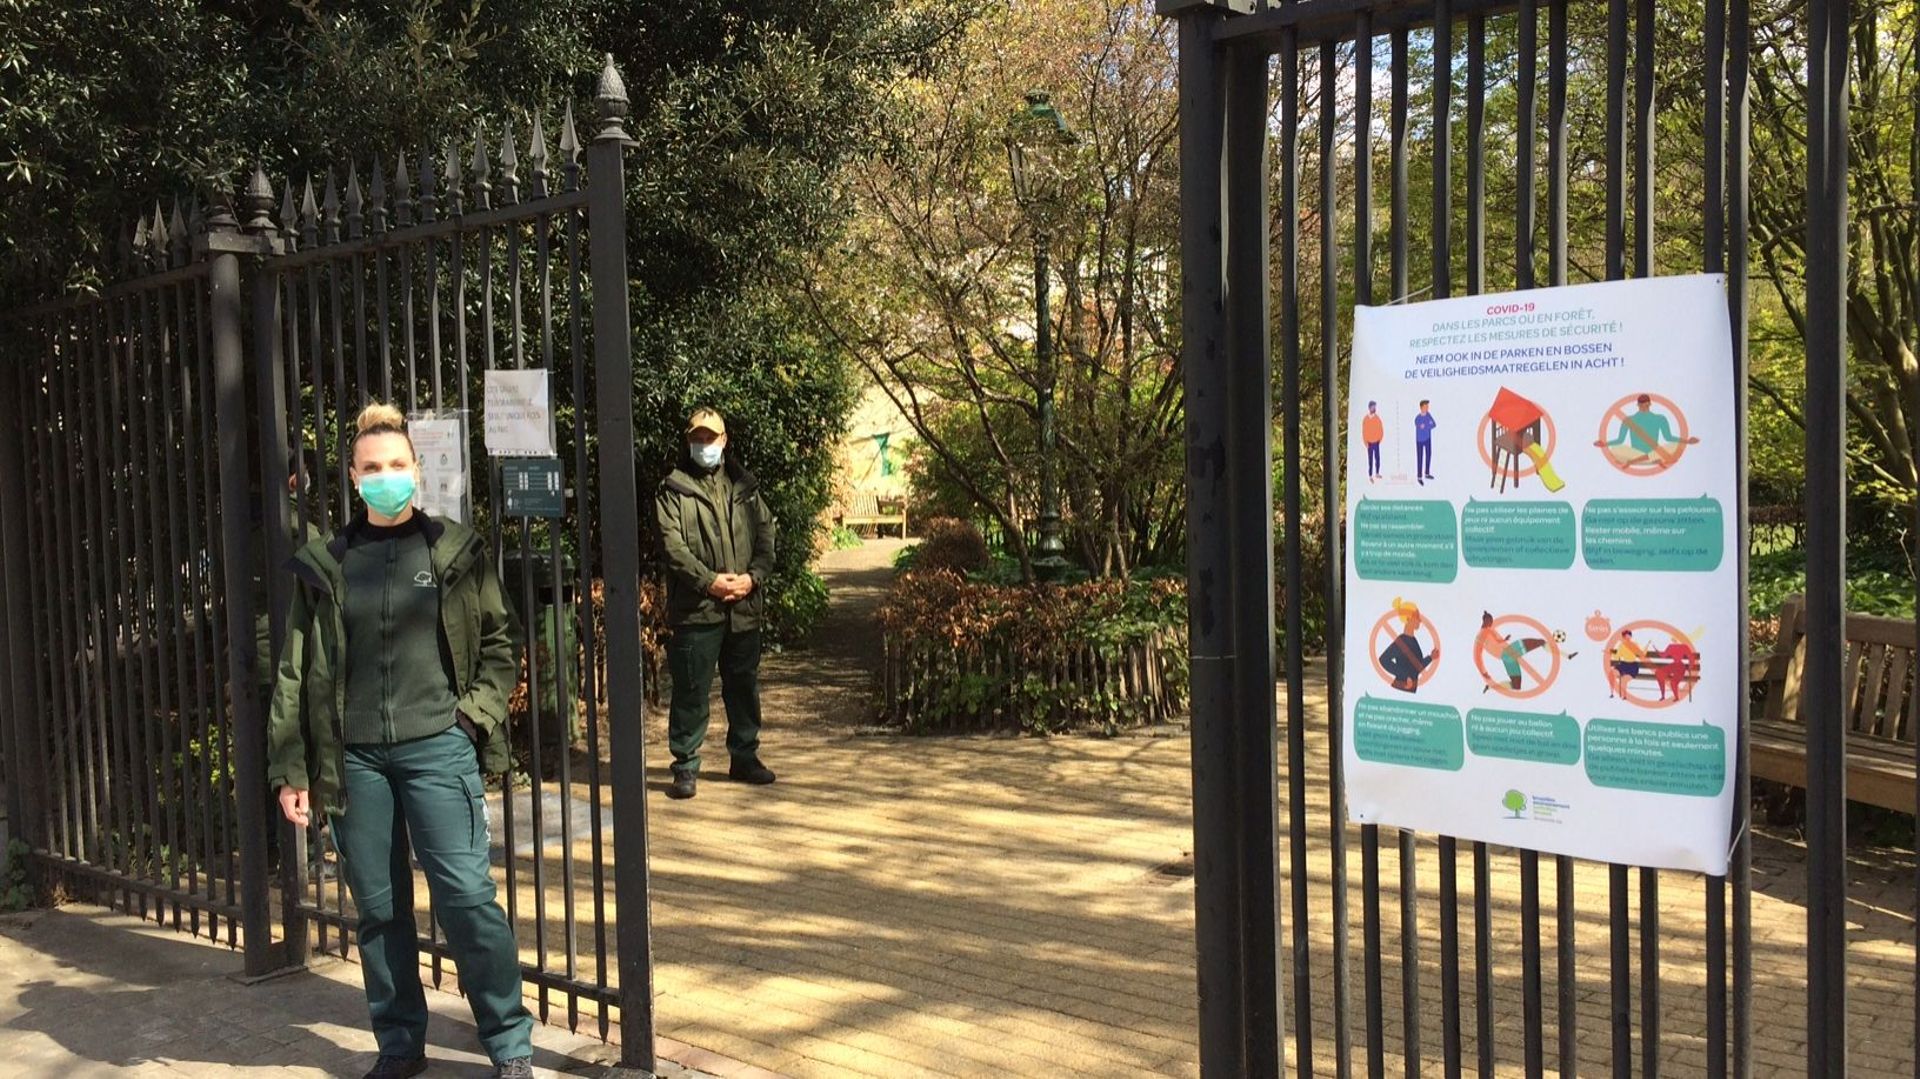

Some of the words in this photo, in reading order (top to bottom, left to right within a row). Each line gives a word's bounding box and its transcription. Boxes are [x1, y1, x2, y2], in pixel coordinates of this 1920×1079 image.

[1486, 302, 1535, 316] COVID-19
[1432, 321, 1459, 333] DANS
[1461, 319, 1481, 330] LES
[1482, 316, 1516, 328] PARCS
[1518, 313, 1535, 325] OU
[1537, 311, 1553, 323] EN
[1554, 306, 1595, 320] FORÊT,
[1409, 335, 1466, 348] RESPECTEZ
[1467, 332, 1487, 343] LES
[1489, 328, 1540, 341] MESURES
[1541, 327, 1557, 338] DE
[1559, 320, 1617, 336] SÉCURITÉ
[1415, 354, 1444, 364] NEEM
[1445, 351, 1469, 363] OOK
[1471, 351, 1482, 361] IN
[1484, 350, 1498, 360] DE
[1501, 347, 1544, 359] PARKEN
[1546, 346, 1561, 356] EN
[1564, 343, 1612, 355] BOSSEN
[1405, 369, 1418, 379] DE
[1420, 359, 1568, 378] VEILIGHEIDSMAATREGELEN
[1571, 360, 1582, 369] IN
[1585, 357, 1619, 369] ACHT
[1587, 724, 1617, 734] Utiliser
[1631, 728, 1657, 737] bancs
[1658, 730, 1690, 740] publics
[1587, 735, 1628, 745] personne
[1643, 737, 1659, 746] fois
[1671, 741, 1720, 751] seulement
[1587, 745, 1626, 755] quelques
